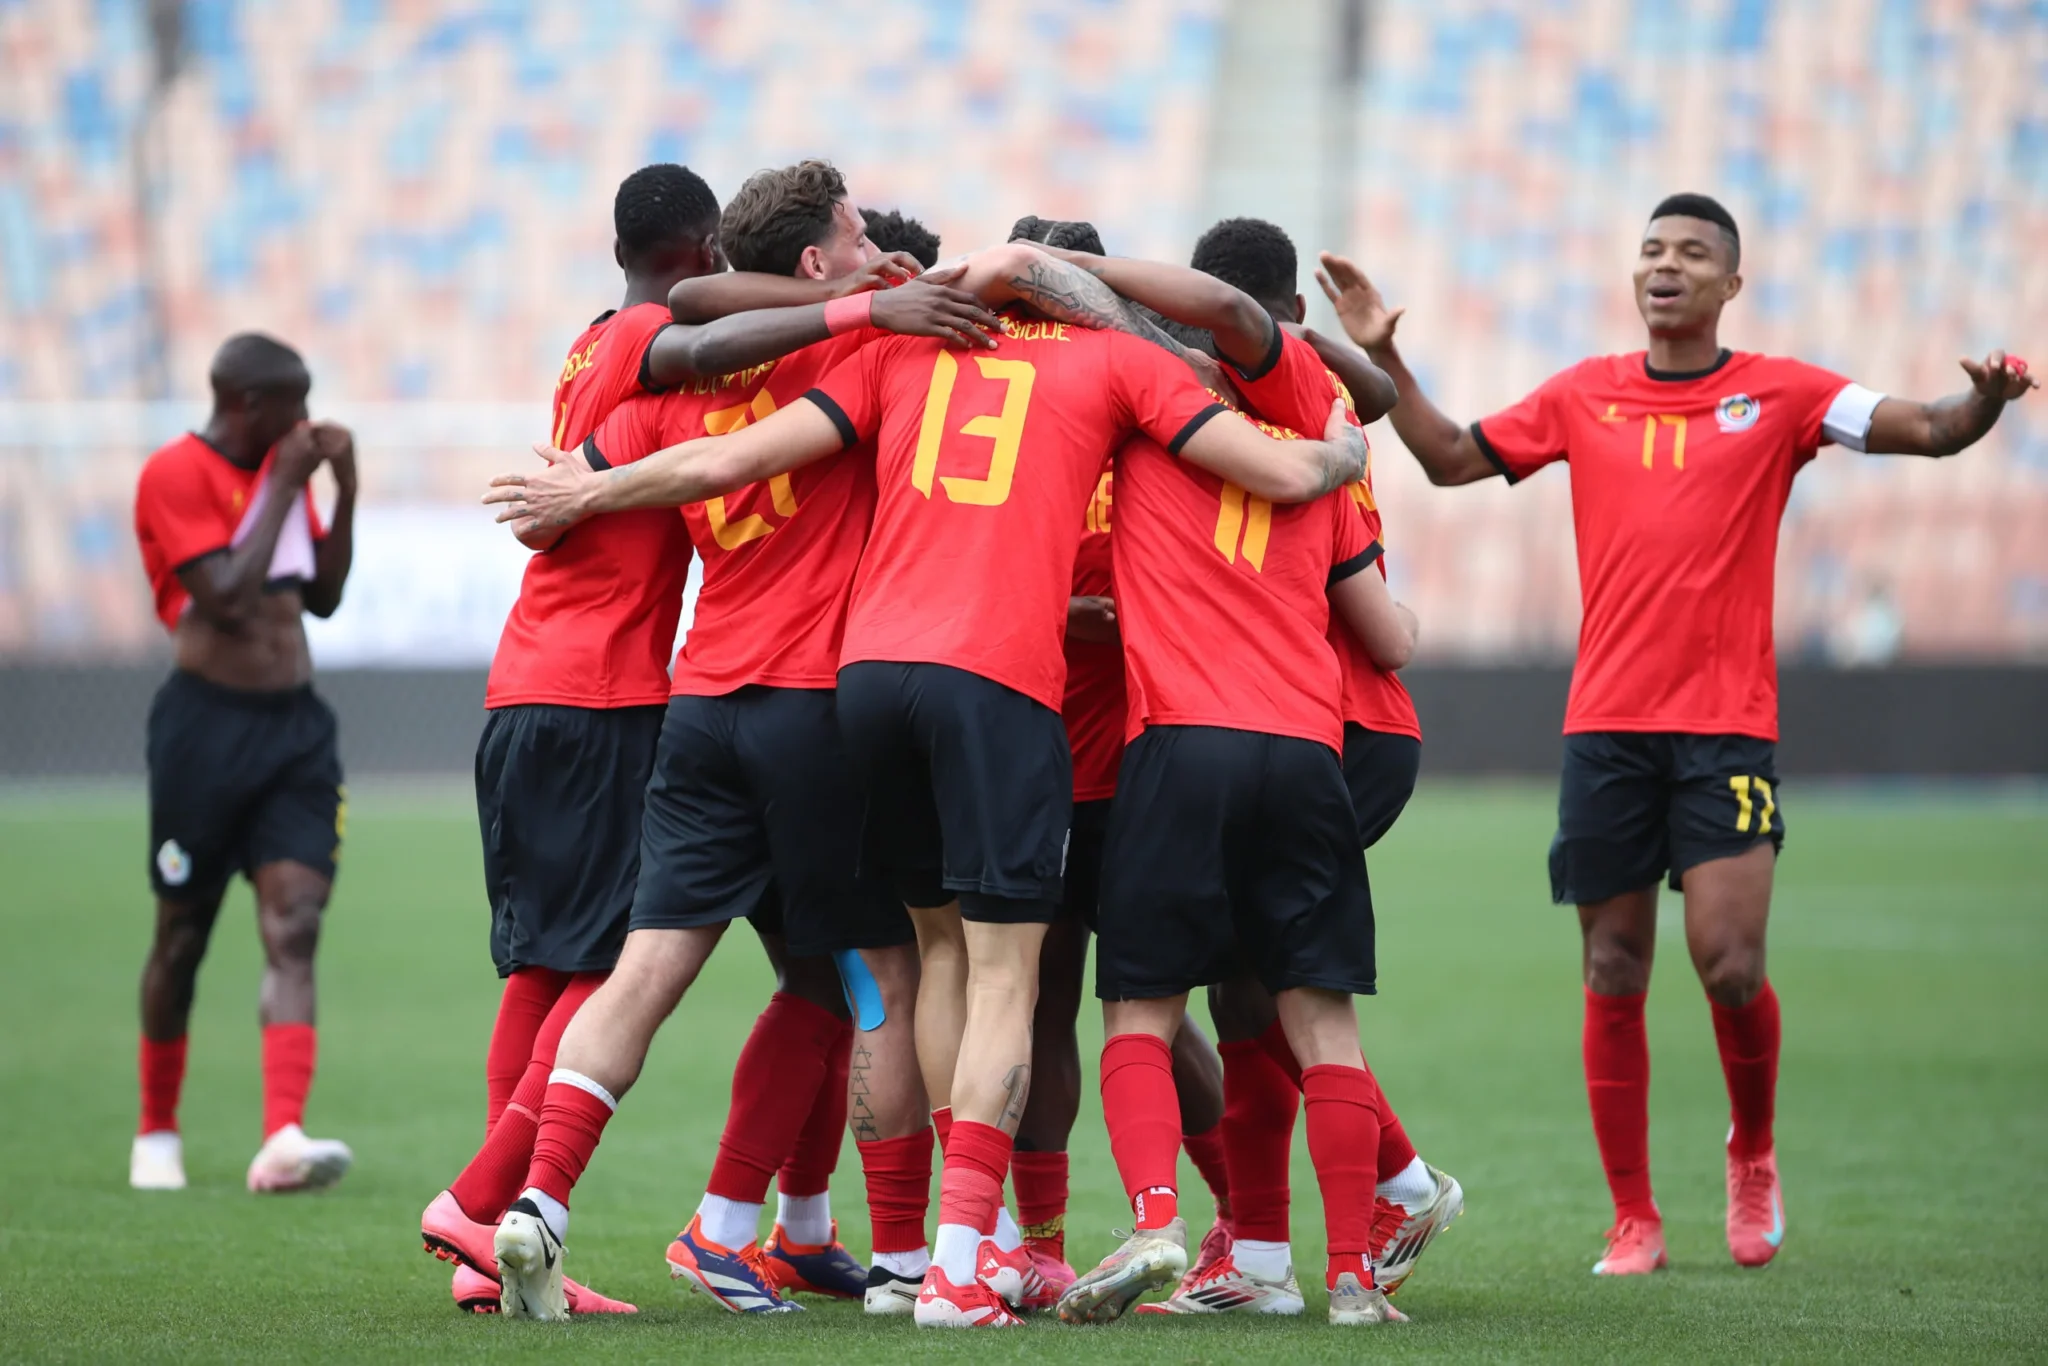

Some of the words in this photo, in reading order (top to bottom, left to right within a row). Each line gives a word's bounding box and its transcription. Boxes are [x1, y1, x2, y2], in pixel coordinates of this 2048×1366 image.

[911, 349, 1037, 506] 13
[1642, 413, 1687, 471] 17
[1214, 480, 1272, 573] 11
[1729, 775, 1775, 835] 17
